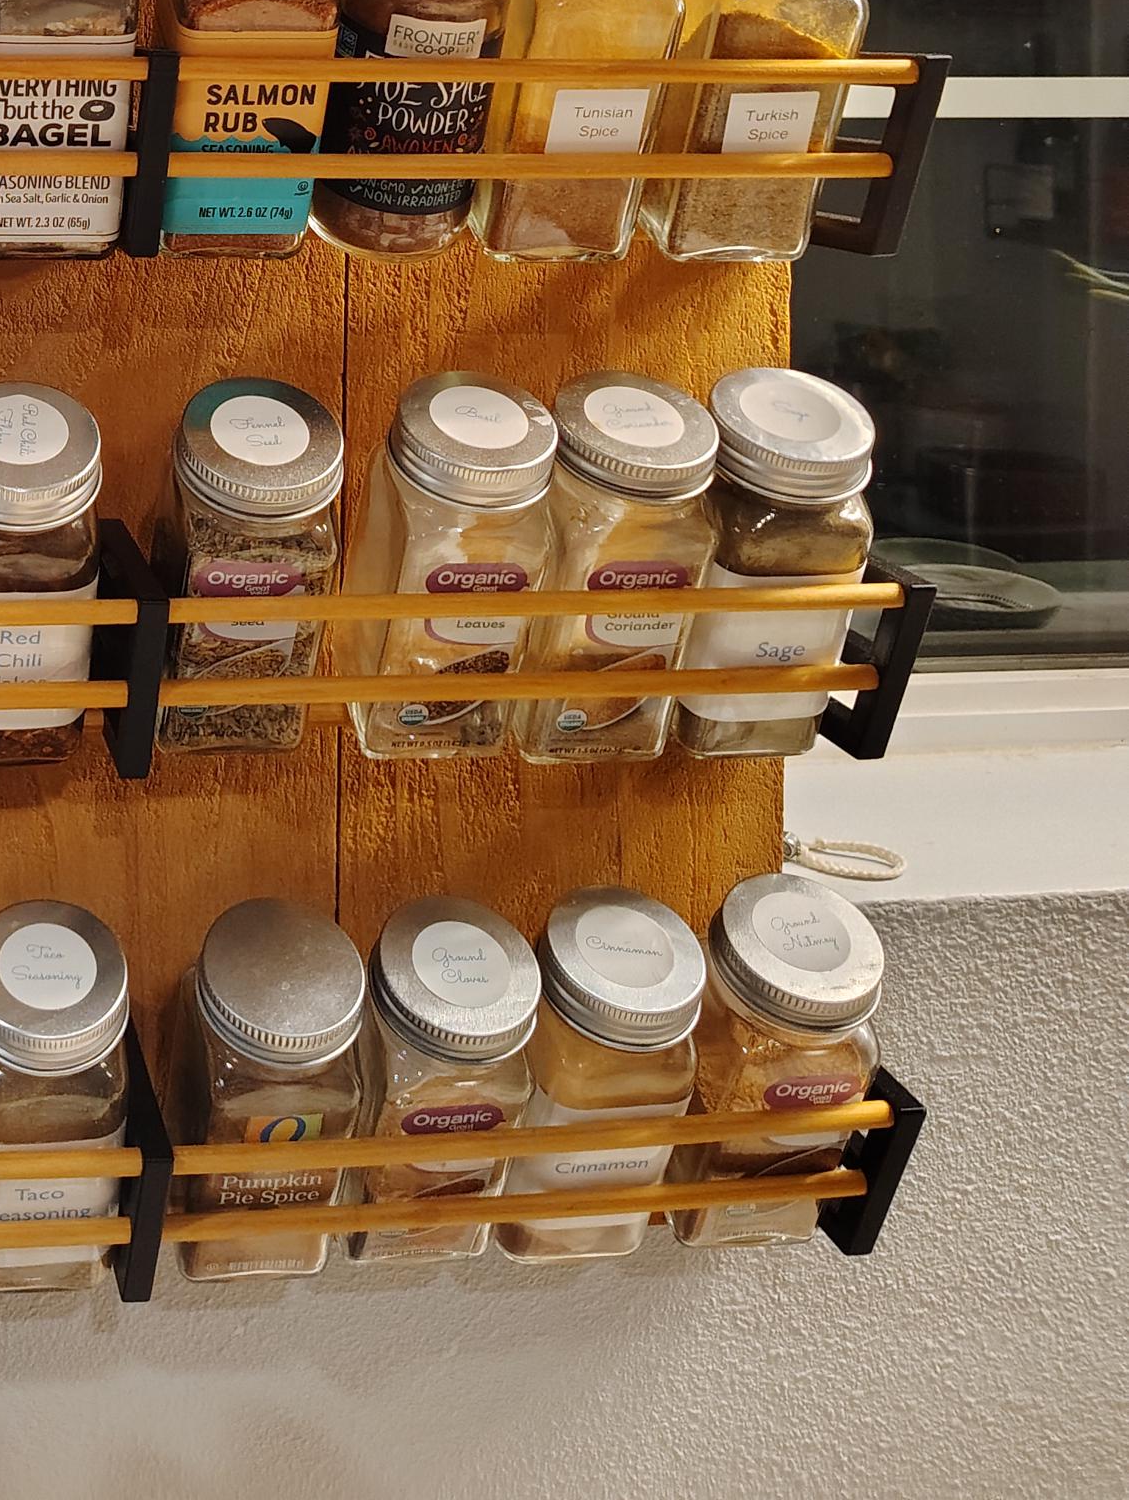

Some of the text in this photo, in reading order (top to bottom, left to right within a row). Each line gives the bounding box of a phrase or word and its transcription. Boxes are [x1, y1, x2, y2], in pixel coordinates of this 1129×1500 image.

[393, 24, 476, 46] FRONTIER
[415, 44, 455, 56] CO-OP
[206, 84, 317, 106] SALMON
[3, 99, 74, 120] but the
[574, 106, 633, 119] Tunisian
[746, 108, 799, 122] Turkish
[204, 112, 258, 133] RUB
[376, 102, 468, 136] POWDER
[579, 125, 619, 139] Spice
[748, 128, 789, 142] Spice
[201, 145, 274, 154] SEASONING
[65, 176, 110, 190] BLEND
[5, 193, 21, 203] Sea
[23, 193, 44, 205] Salt,
[45, 193, 71, 203] Garlic
[72, 194, 80, 203] &
[81, 194, 108, 204] Onion
[363, 187, 462, 208] NON-IRRADIATED
[199, 207, 293, 220] NET WT. 2.6 OZ (74g)
[16, 217, 33, 228] WT.
[35, 217, 50, 228] 2.3
[53, 217, 65, 227] OZ
[67, 217, 90, 230] (65g)
[207, 570, 289, 588] Organic
[438, 570, 518, 589] Organic
[599, 570, 678, 589] Organic
[457, 619, 506, 629] Leaves
[604, 621, 675, 632] Coriander
[0, 631, 41, 645] Red
[755, 642, 805, 662] Sage
[585, 935, 664, 958] Cinnamon
[775, 1081, 852, 1099] Organic
[413, 1111, 492, 1129] Organic
[555, 1159, 648, 1174] Cinnamon
[222, 1172, 322, 1190] Pumpkin
[15, 1188, 64, 1201] Taco
[220, 1190, 320, 1205] Pie Spice
